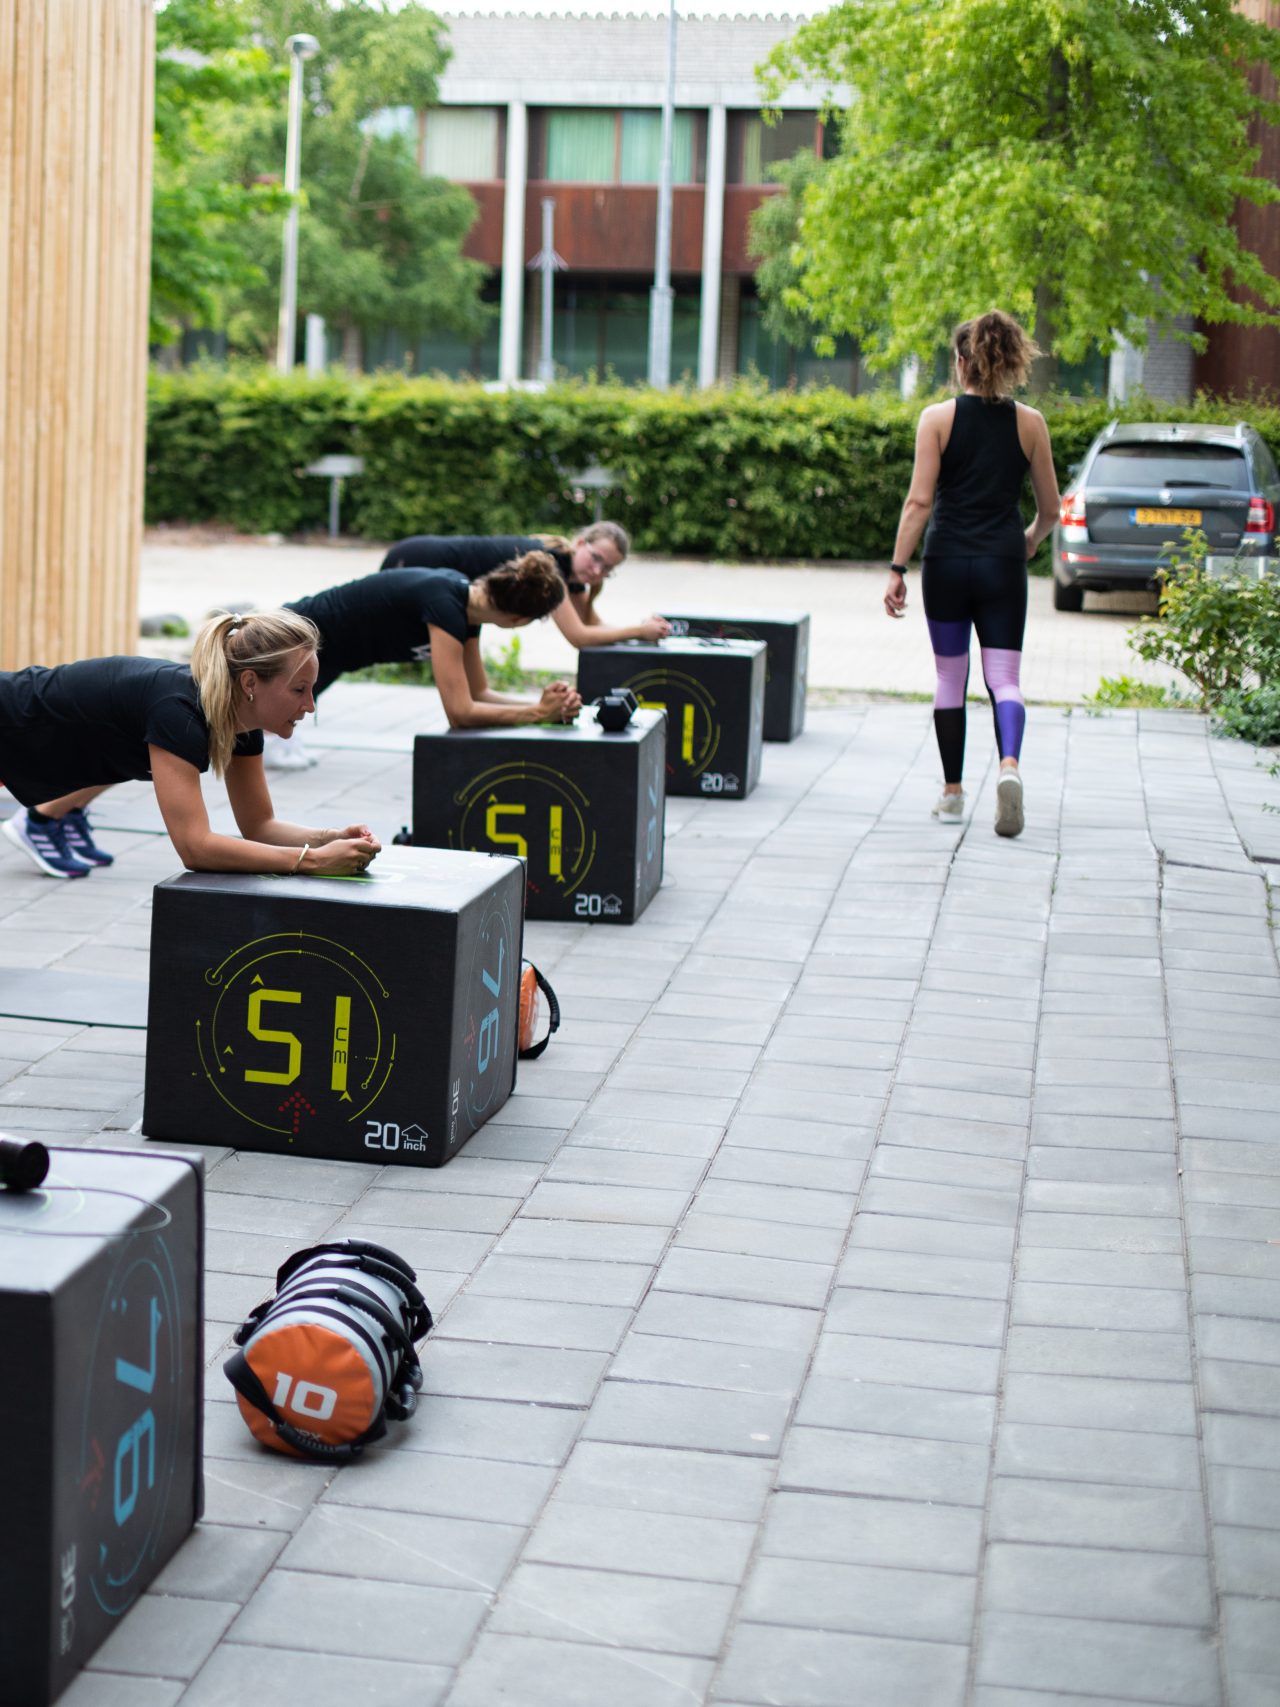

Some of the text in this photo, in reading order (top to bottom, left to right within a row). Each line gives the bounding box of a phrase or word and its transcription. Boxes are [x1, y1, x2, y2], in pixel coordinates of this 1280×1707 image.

[701, 772, 723, 792] 20
[486, 803, 562, 875] 51
[575, 893, 601, 916] 20
[244, 988, 351, 1092] 51
[364, 1120, 426, 1152] 20 inch
[272, 1371, 338, 1421] 10
[60, 1542, 77, 1610] 30
